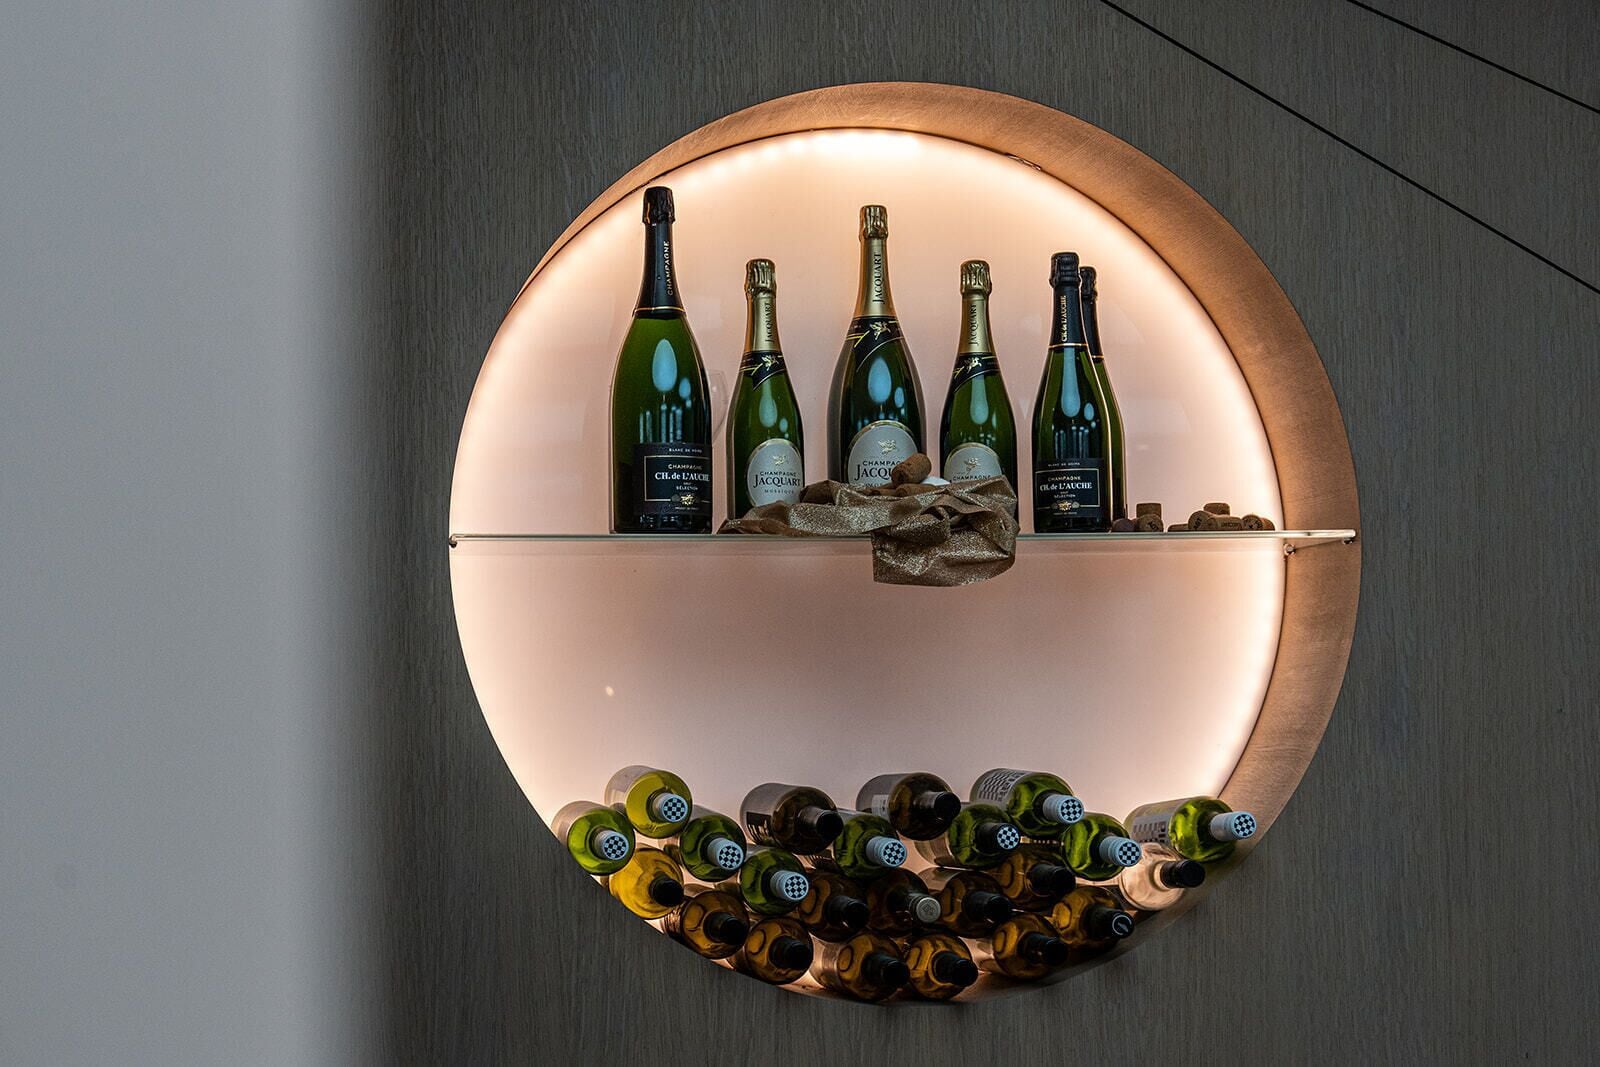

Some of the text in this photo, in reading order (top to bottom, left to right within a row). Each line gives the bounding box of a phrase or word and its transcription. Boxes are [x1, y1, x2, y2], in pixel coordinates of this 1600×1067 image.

[872, 253, 884, 304] JACQUART
[765, 302, 775, 343] JACQUART
[968, 304, 979, 346] JACQUART
[671, 472, 681, 480] de
[753, 474, 801, 488] JACQUART
